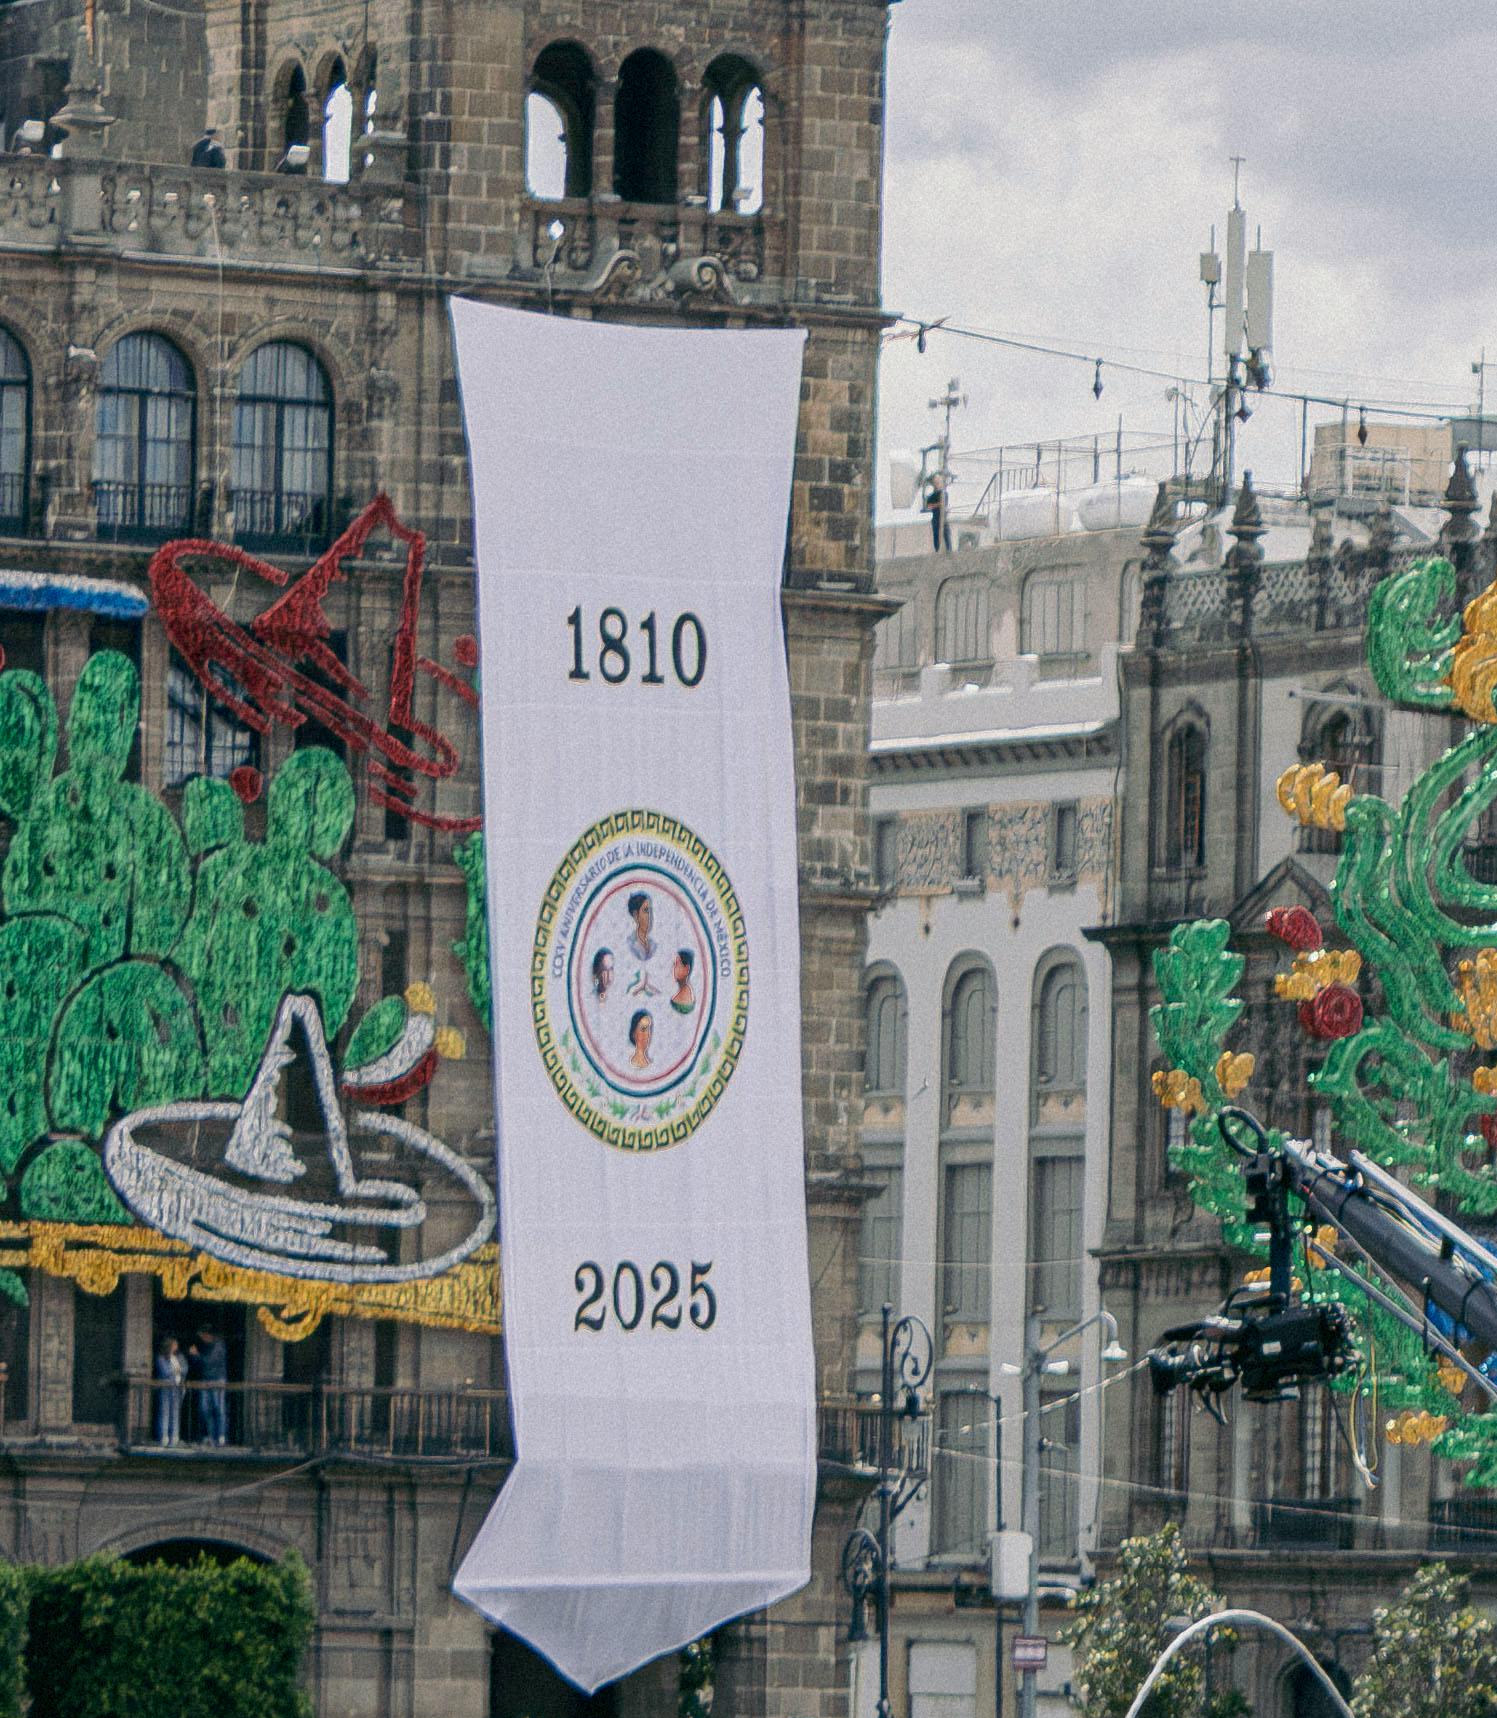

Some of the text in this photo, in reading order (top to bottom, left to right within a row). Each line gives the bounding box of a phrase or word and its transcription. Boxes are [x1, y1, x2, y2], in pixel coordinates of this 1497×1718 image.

[567, 604, 707, 687] 1810
[560, 855, 607, 938] ANIVERSARIO
[606, 846, 622, 865] DE
[636, 841, 708, 901] INDEPENDENCIA
[574, 1260, 717, 1332] 2025
